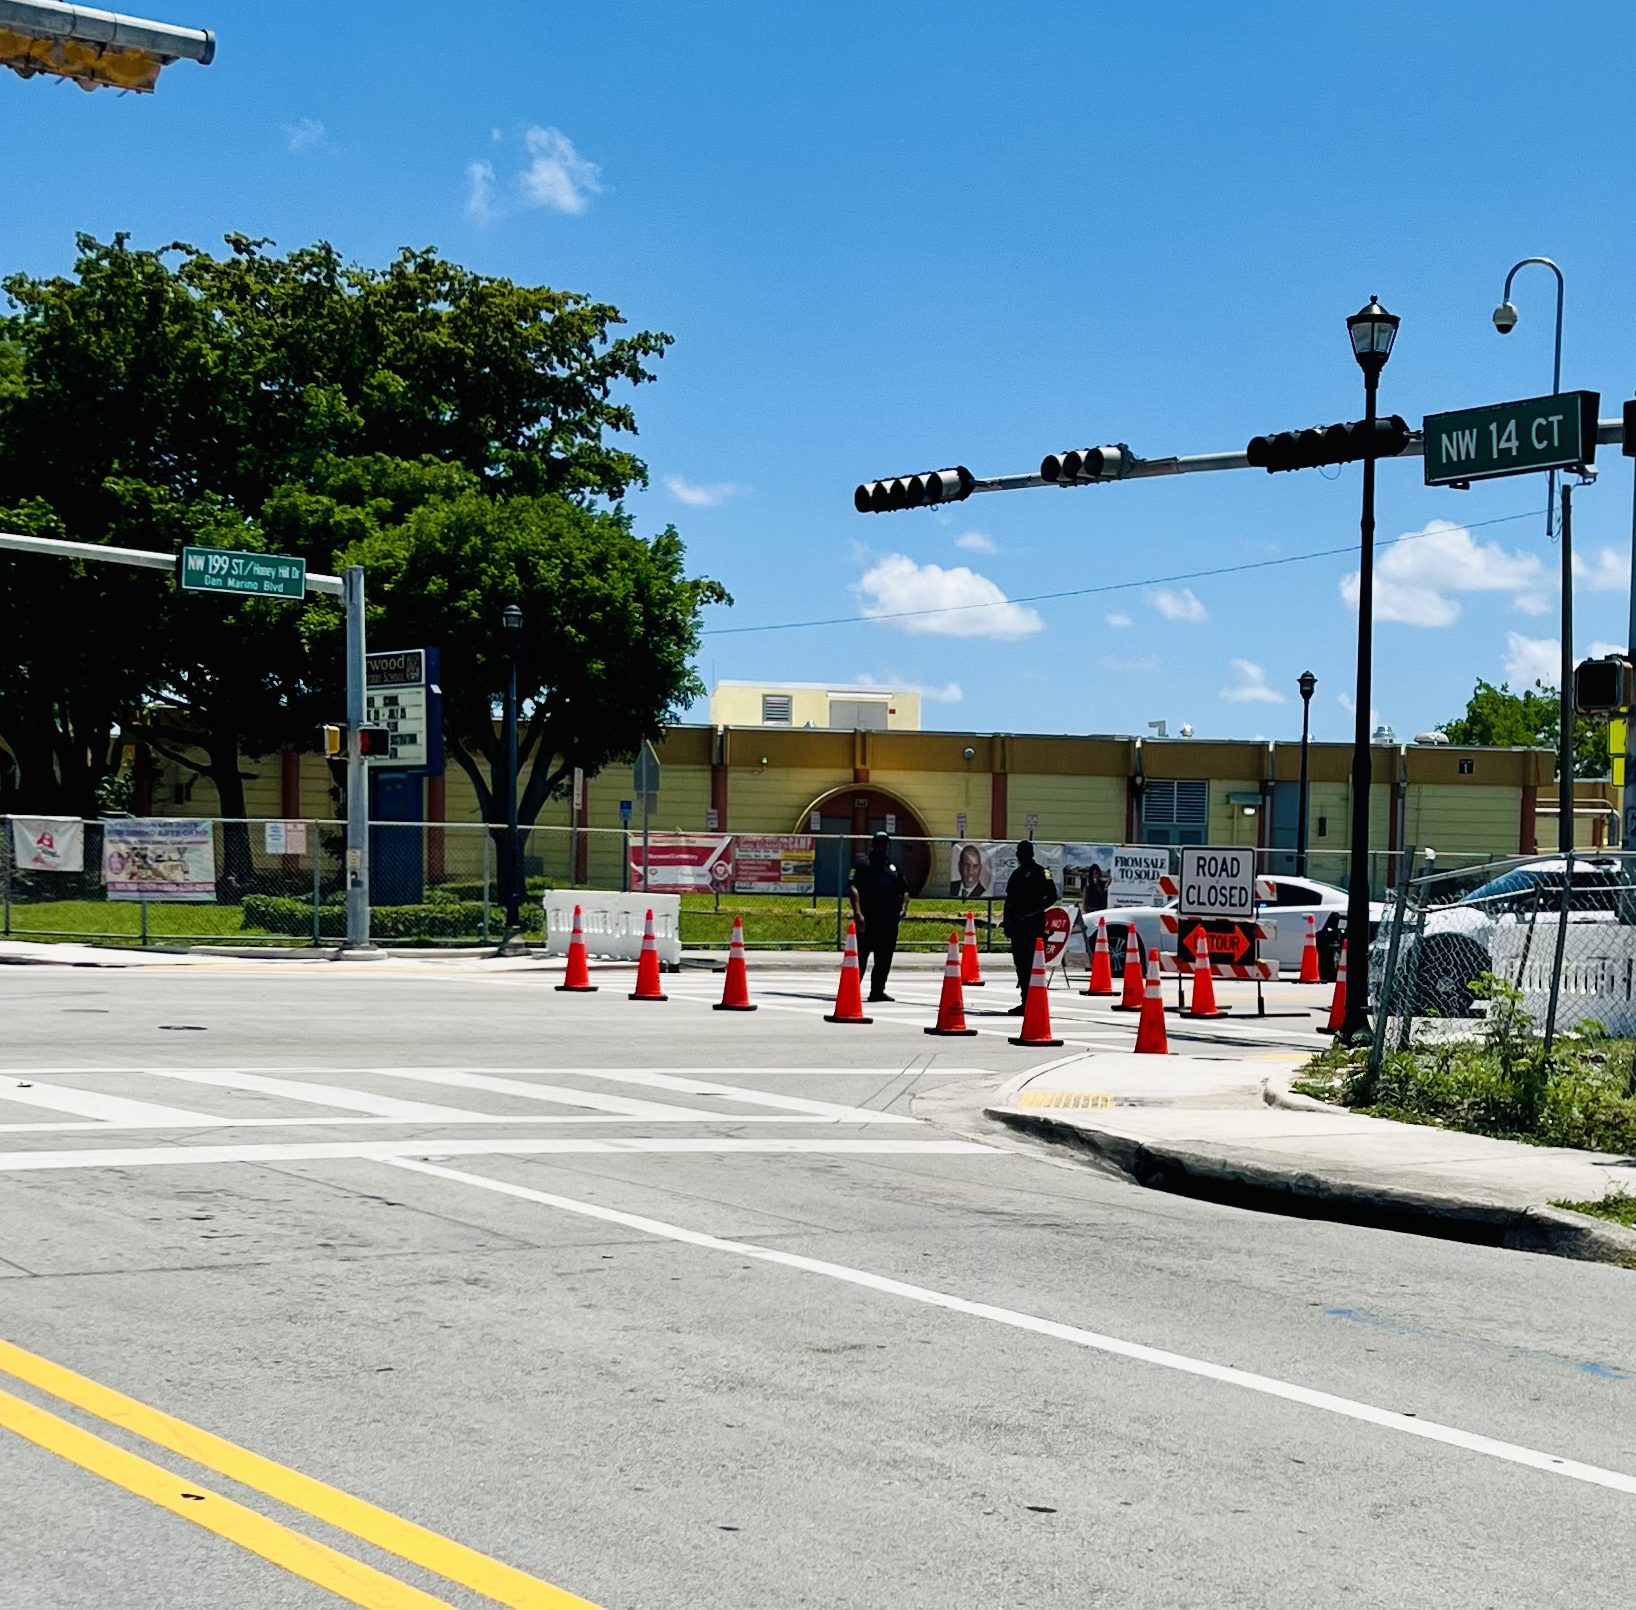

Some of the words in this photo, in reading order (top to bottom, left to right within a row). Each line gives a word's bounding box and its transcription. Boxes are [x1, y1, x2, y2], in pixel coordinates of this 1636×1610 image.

[1441, 428, 1477, 464] NW
[1489, 419, 1519, 459] 14
[1531, 414, 1563, 450] CT
[187, 554, 205, 571] NW
[208, 554, 229, 575] 199
[291, 567, 300, 579] Dr
[204, 574, 222, 586] Dan
[227, 578, 259, 590] Marino
[263, 580, 284, 593] Blvd
[1114, 855, 1142, 868] FROM
[1143, 857, 1166, 869] SALE
[1196, 856, 1241, 878] ROAD
[1119, 868, 1133, 879] TO
[1134, 869, 1160, 880] SOLD
[1186, 885, 1249, 908] CLOSED
[1050, 919, 1067, 929] NOT
